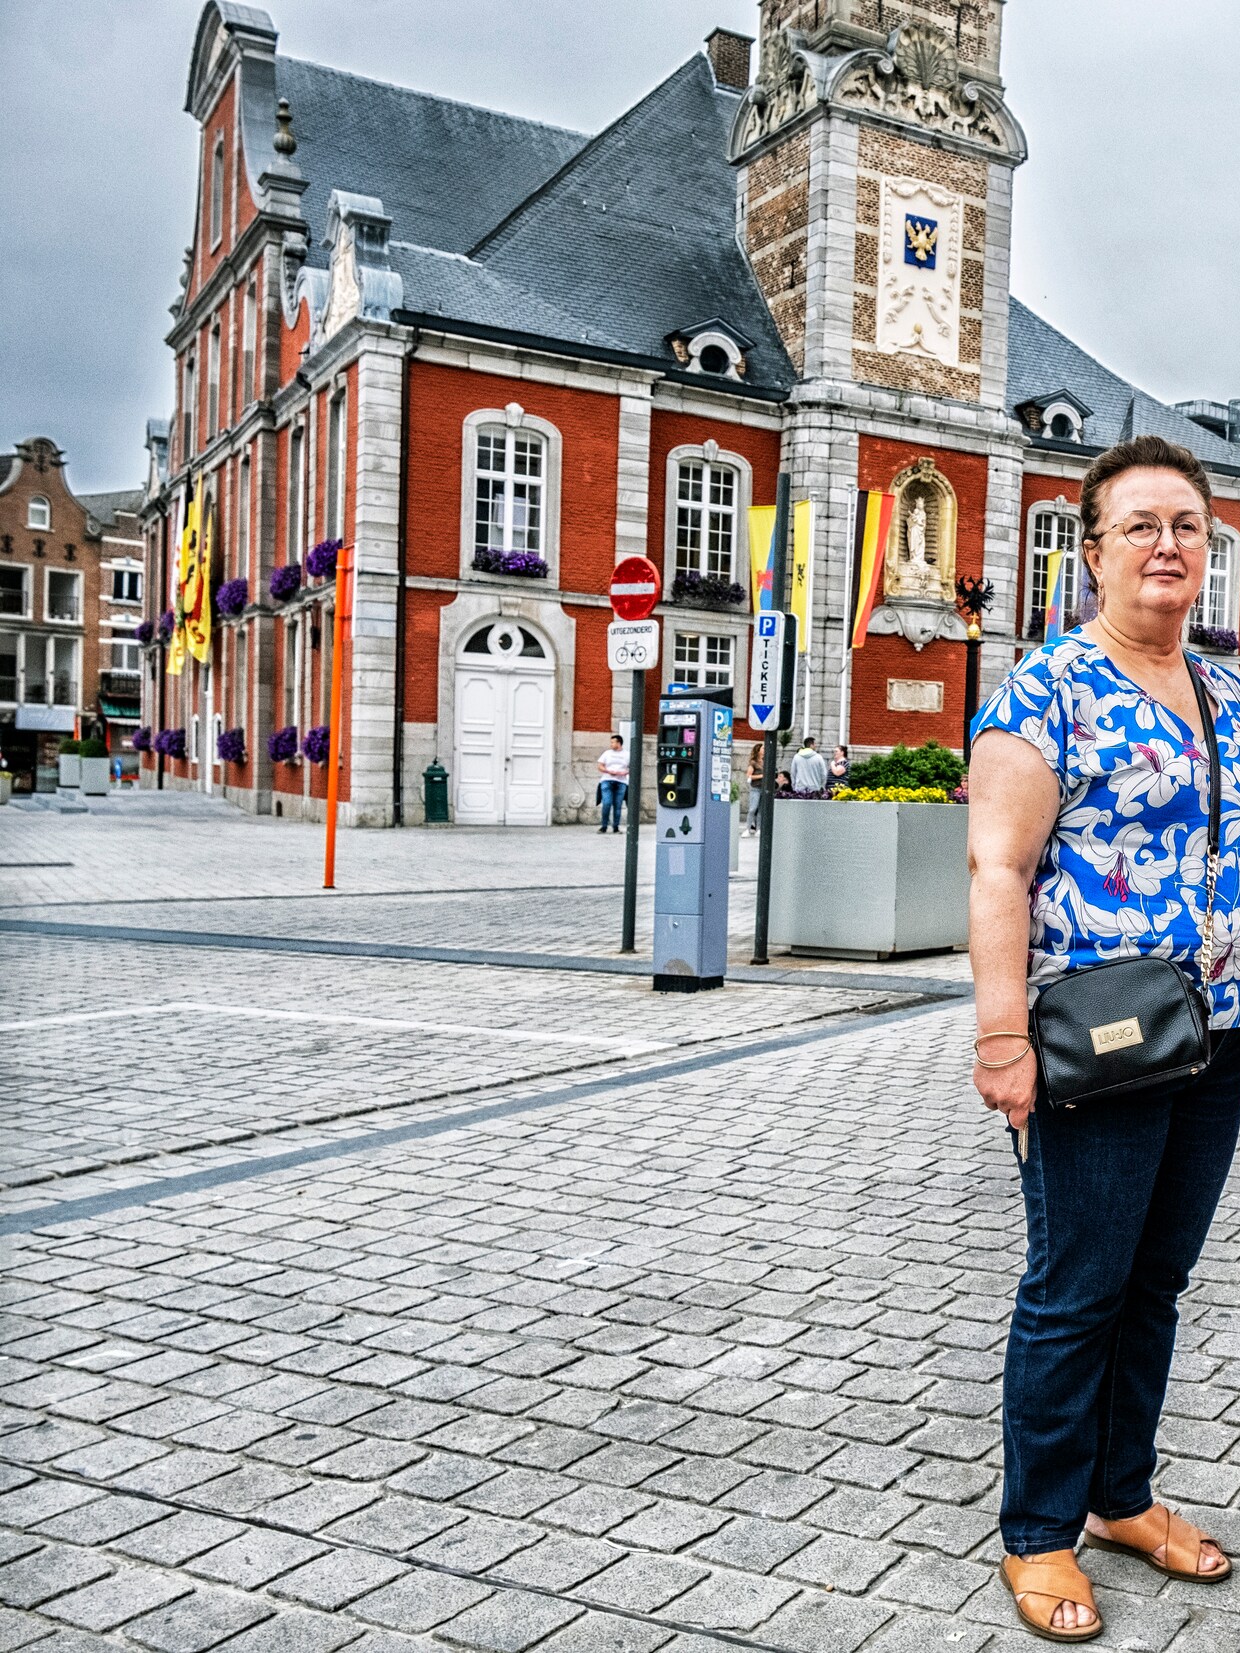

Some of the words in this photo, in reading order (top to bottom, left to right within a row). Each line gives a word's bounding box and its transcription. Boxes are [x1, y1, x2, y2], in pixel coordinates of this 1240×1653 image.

[610, 625, 653, 635] UITGEZONDERD
[762, 618, 773, 635] P
[760, 638, 770, 703] TICKET
